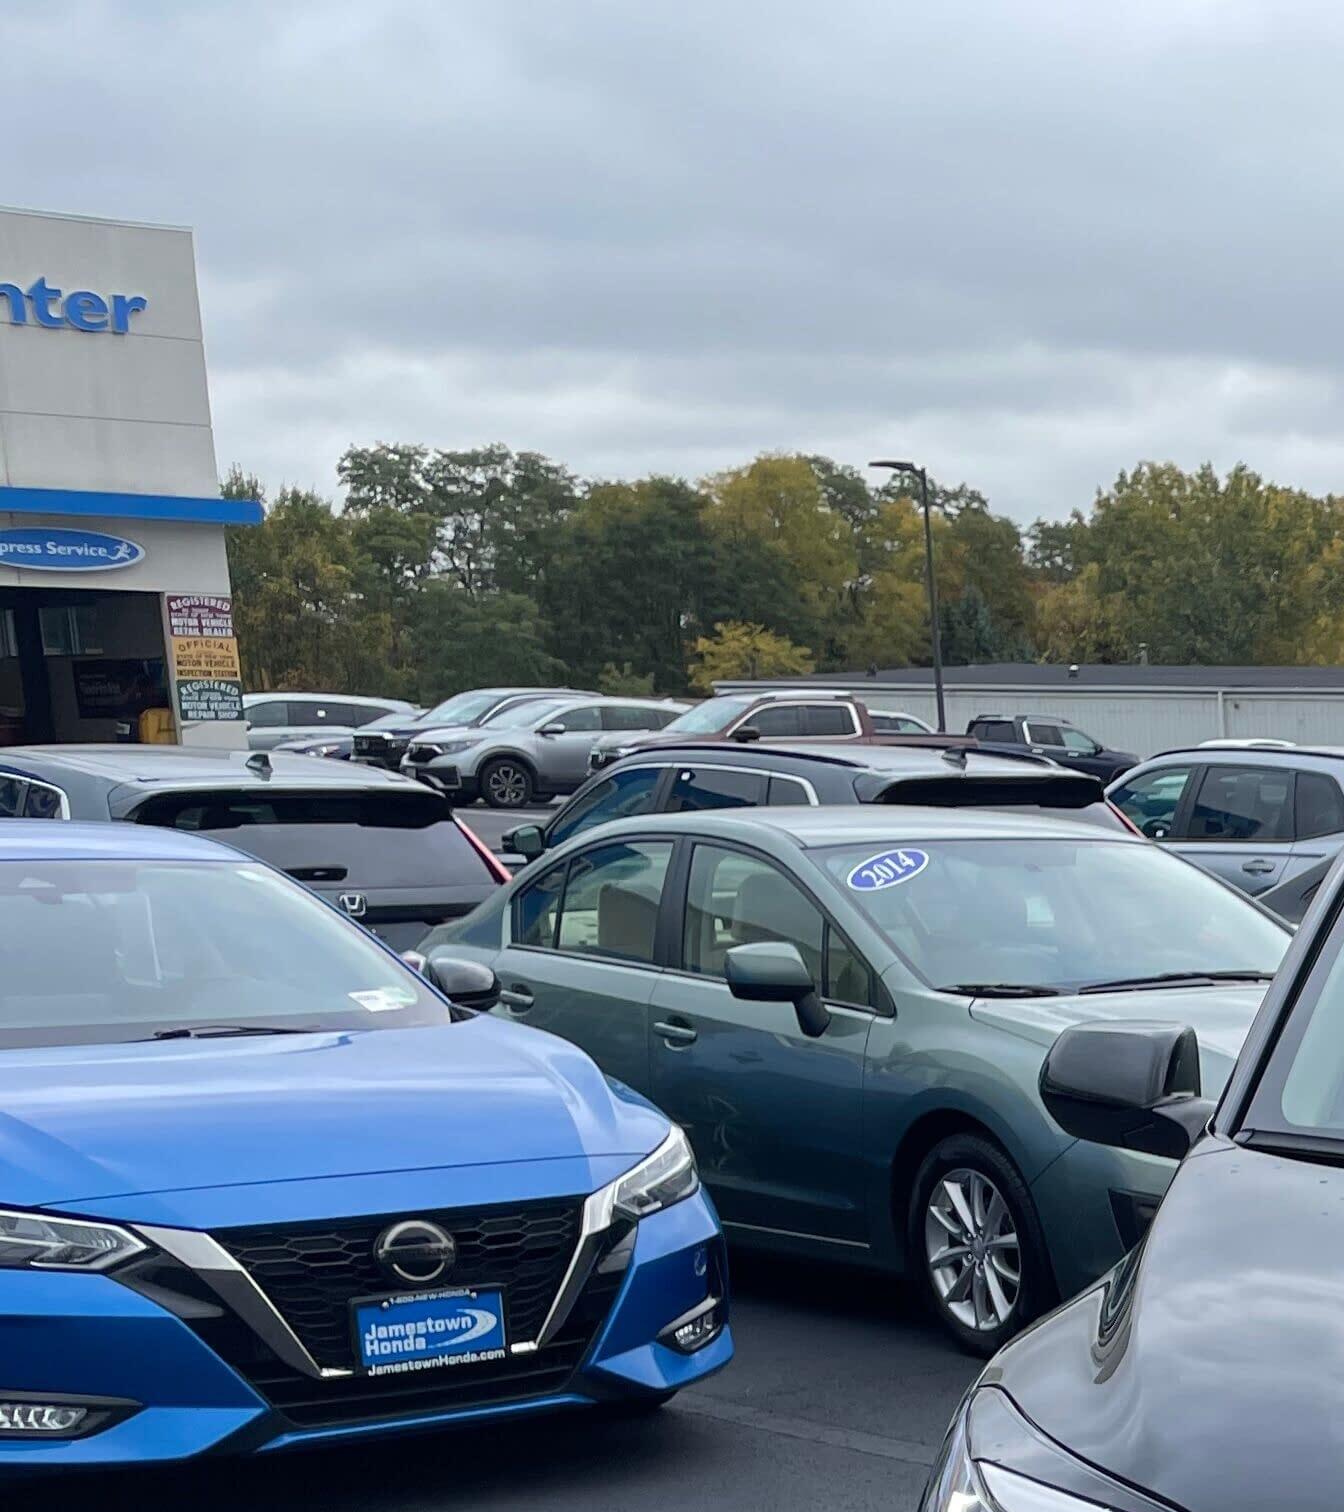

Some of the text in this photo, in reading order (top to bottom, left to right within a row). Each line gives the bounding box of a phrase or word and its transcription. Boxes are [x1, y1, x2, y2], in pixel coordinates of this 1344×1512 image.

[46, 541, 109, 557] Service
[170, 596, 231, 611] REGISTERED
[171, 617, 232, 628] MOTOR VEHICLE
[178, 640, 232, 653] OFFICIAL
[205, 660, 236, 668] VEHICLE
[180, 681, 239, 696] REGISTERED
[181, 701, 242, 711] MOTOR VEHICLE
[188, 710, 239, 720] REPAIR SHOP
[861, 850, 916, 888] 2014
[365, 1315, 473, 1340] Jamestown
[365, 1336, 427, 1357] Honda
[368, 1349, 505, 1377] JamestownHonda.com
